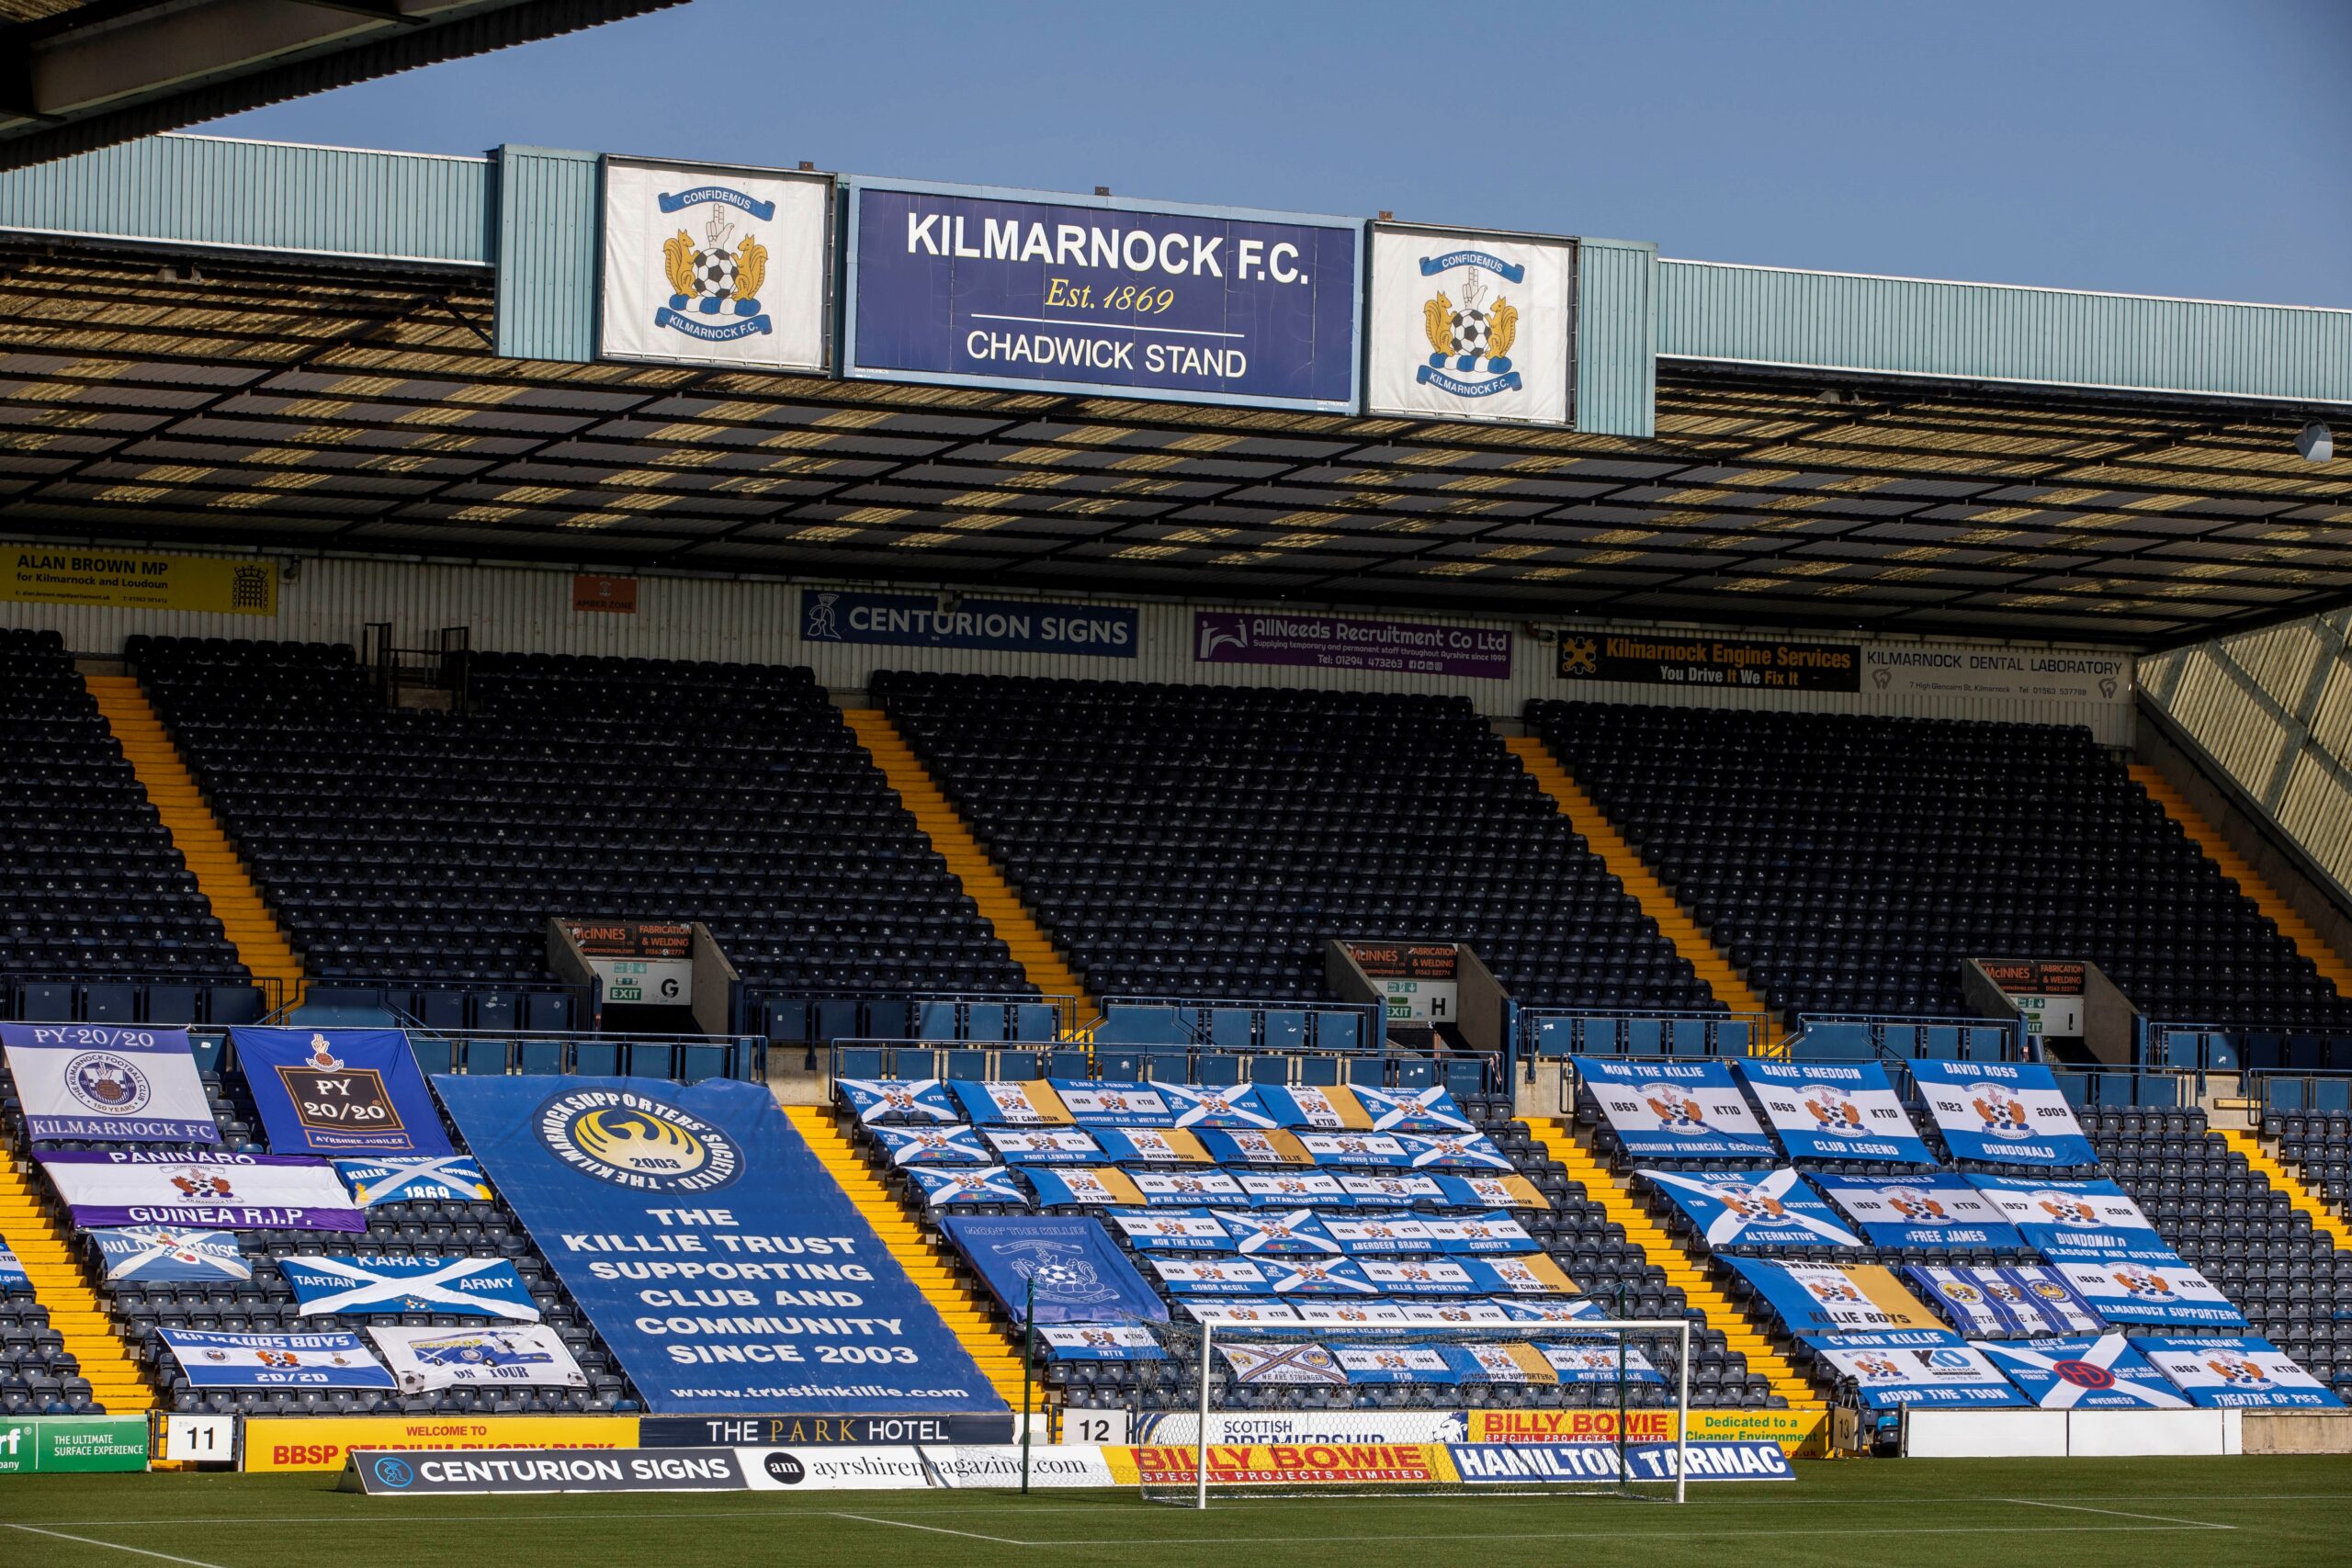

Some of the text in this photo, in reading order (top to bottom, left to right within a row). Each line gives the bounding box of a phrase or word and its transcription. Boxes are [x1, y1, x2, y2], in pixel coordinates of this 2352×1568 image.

[683, 190, 752, 209] CONFIDEMUS
[908, 212, 1308, 285] KILMARNOCK F.C.
[1442, 254, 1503, 272] CONFIDEMUS
[1046, 278, 1174, 314] Est. 1869
[669, 315, 758, 339] KILMARNOCK F.C.
[967, 331, 1247, 378] CHADWICK STAND
[1430, 373, 1510, 395] KILMARNOCK F.C.
[17, 554, 168, 575] ALAN BROWN MP
[17, 572, 168, 589] for Kilmarnock and Loudoun
[577, 600, 633, 609] AMBER ZONE
[849, 605, 1128, 645] CENTURION SIGNS
[1253, 618, 1507, 651] AllNeeds Recruitment Co Ltd
[1253, 639, 1507, 661] Supplying temporary and permanent staff throughout Ayrshire since 1999
[1606, 637, 1851, 669] Kilmarnock Engine Services
[1317, 654, 1403, 670] Tel: 01294 473263
[1868, 651, 2121, 675] KILMARNOCK DENTAL LABORATORY
[1660, 665, 1799, 685] You Drive It We Fix It
[2041, 964, 2084, 974] FABRICATION
[611, 989, 639, 999] EXIT
[662, 978, 678, 998] G
[1432, 998, 1445, 1016] H
[34, 1027, 155, 1048] PY-20/20
[1600, 1065, 1705, 1077] MON THE KILLIE
[1762, 1065, 1861, 1079] DAVIE SNEDDON
[1943, 1063, 2018, 1078] DAVID ROSS
[315, 1078, 352, 1097] PY
[303, 1101, 386, 1121] 20/20
[1611, 1102, 1741, 1115] 1869 KTID
[1769, 1102, 1898, 1119] 1869 KTID
[1937, 1101, 2067, 1117] 1923 2009
[32, 1120, 215, 1140] KILMARNOCK FC
[1314, 1118, 1338, 1126] KTID
[315, 1135, 405, 1145] AYRSHIRE JUBILEE
[1813, 1141, 1900, 1156] CLUB LEGEND
[1982, 1143, 2055, 1158] DUNDONALD
[109, 1151, 257, 1165] PANINARO
[629, 1157, 682, 1169] 2003
[1702, 1173, 1745, 1181] KILLIE
[1852, 1201, 1881, 1210] 1869
[129, 1207, 312, 1225] GUINEA R.I.P.
[646, 1209, 740, 1226] THE
[1745, 1233, 1818, 1241] ALTERNATIVE
[1905, 1230, 1987, 1243] #FREE JAMES
[561, 1235, 855, 1255] KILLIE TRUST
[1352, 1241, 1431, 1250] ABERDEEN BRANCH
[2045, 1247, 2182, 1261] GLASGOW AND DISTRICT
[357, 1256, 440, 1269] KARA'S
[589, 1262, 876, 1281] SUPPORTING
[293, 1275, 514, 1290] TARTAN ARMY
[2076, 1275, 2207, 1288] 1869 KTID
[639, 1290, 864, 1307] CLUB AND
[1808, 1312, 1911, 1324] KILLIE BOYS
[2096, 1304, 2242, 1321] KILMARNOCK SUPPORTERS
[635, 1317, 903, 1336] COMMUNITY
[1826, 1332, 1944, 1346] C'MON KILLIE
[666, 1344, 920, 1364] SINCE 2003
[453, 1366, 529, 1379] ON TOUR
[2272, 1365, 2301, 1373] KTID
[254, 1373, 329, 1382] 20/20
[671, 1383, 969, 1398] www.trustinkillie.com
[2086, 1397, 2135, 1405] INVERNESS
[2211, 1394, 2272, 1406] THEATRE
[2275, 1394, 2289, 1404] OF
[1224, 1420, 1293, 1434] SCOTTISH
[1485, 1413, 1668, 1433] BILLY BOWIE
[1705, 1416, 1797, 1428] Dedicated to a
[187, 1427, 214, 1450] 11
[407, 1426, 487, 1437] WELCOME TO
[707, 1419, 950, 1443] THE PARK HOTEL
[1080, 1420, 1110, 1441] 12
[1685, 1430, 1818, 1444] Cleaner Environment
[55, 1434, 114, 1446] THE ULTIMATE
[54, 1445, 144, 1457] SURFACE EXPERIENCE
[274, 1445, 339, 1465] BBSP
[1132, 1446, 1427, 1471] BILLY BOWIE
[770, 1463, 797, 1474] am
[1456, 1446, 1787, 1478] HAMILTON TARMAC
[420, 1458, 731, 1483] CENTURION SIGNS
[1236, 1471, 1335, 1482] PROJECTS
[1347, 1470, 1425, 1481] LIMITED
